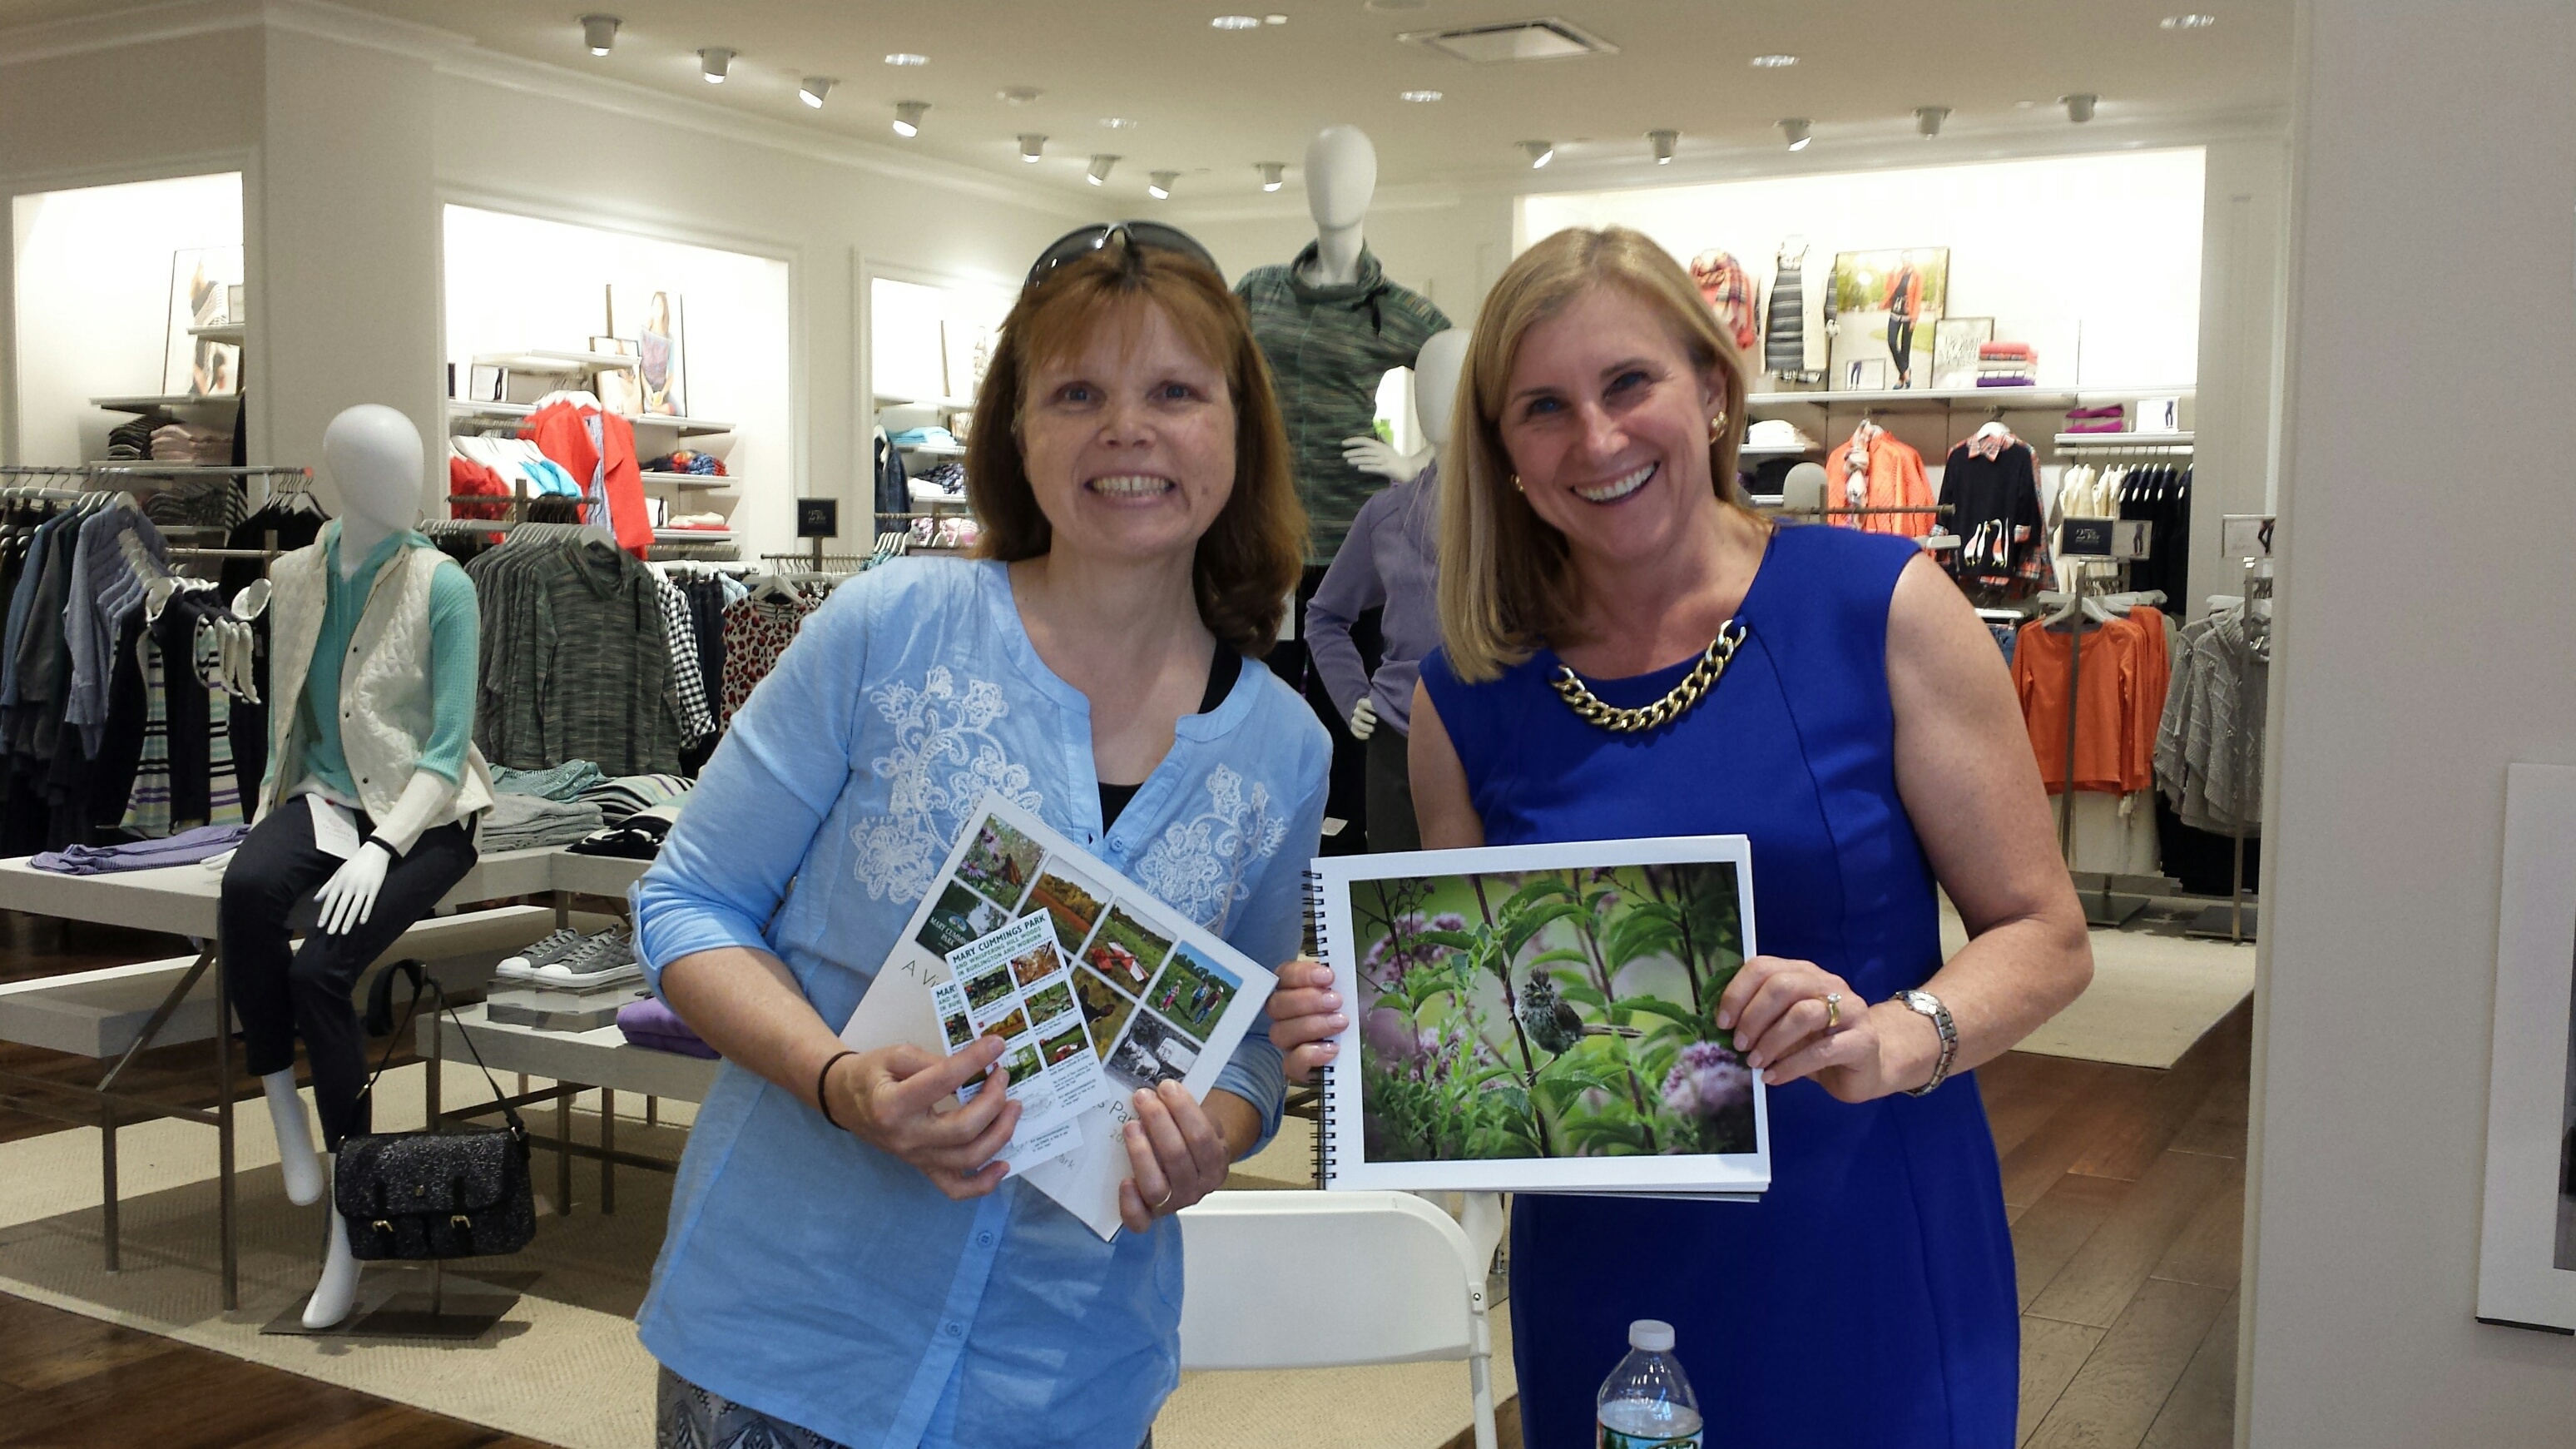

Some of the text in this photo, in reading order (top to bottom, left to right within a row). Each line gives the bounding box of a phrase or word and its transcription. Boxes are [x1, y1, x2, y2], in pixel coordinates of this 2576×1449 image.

[929, 916, 947, 931] MARY
[953, 946, 976, 964] MARY
[978, 925, 1023, 951] CUMMINGS
[1024, 914, 1046, 930] PARK
[956, 925, 1043, 970] AND WHISPERING HILL WOODS
[966, 952, 1003, 973] BURLINGTON
[1003, 945, 1016, 955] AND
[1017, 933, 1043, 947] WOBURN
[901, 960, 915, 977] A
